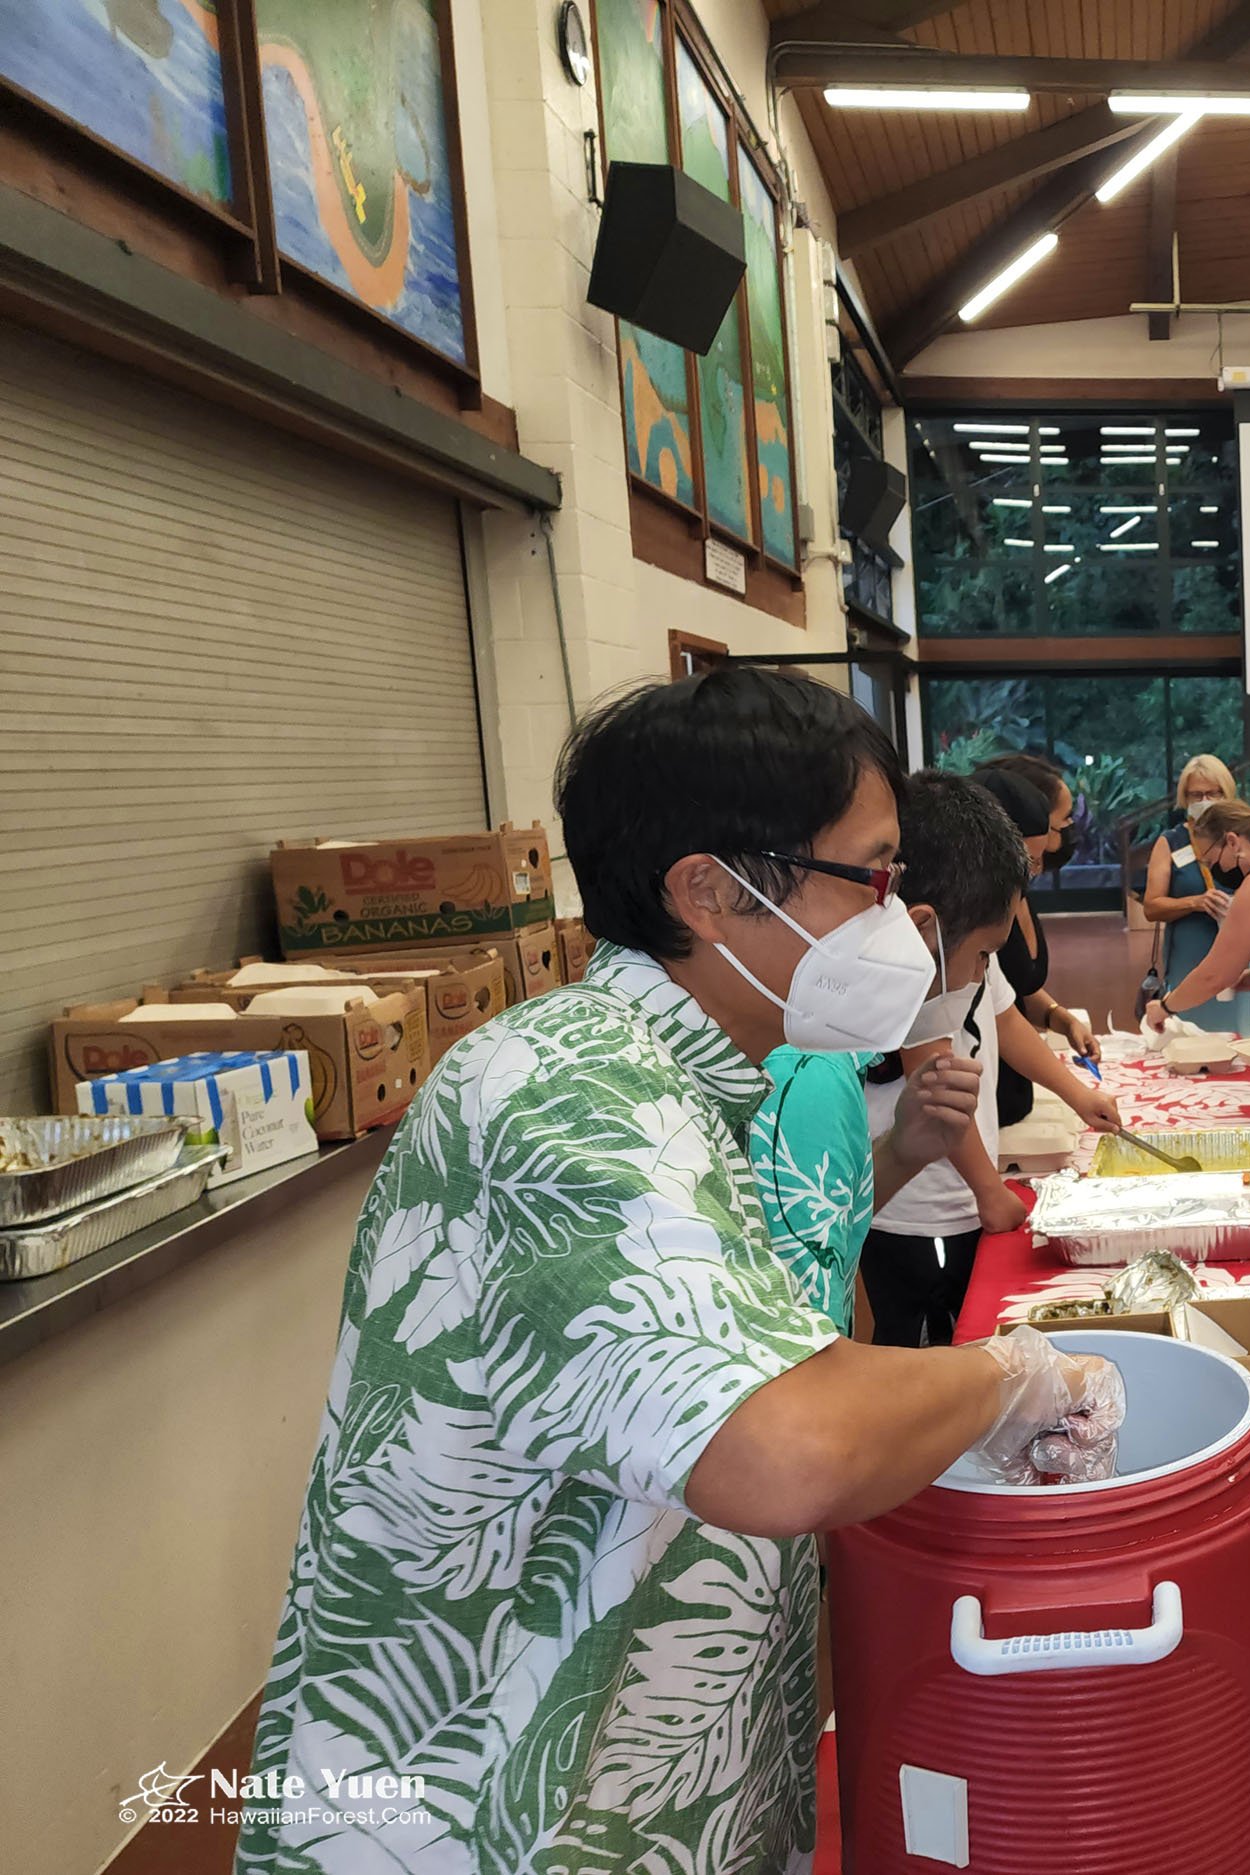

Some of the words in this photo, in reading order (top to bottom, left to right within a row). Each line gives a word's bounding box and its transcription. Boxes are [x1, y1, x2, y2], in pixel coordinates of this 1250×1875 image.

[339, 850, 436, 889] Dole
[360, 901, 427, 918] ORGANIC
[321, 915, 473, 945] BANANAS
[83, 1044, 149, 1071] Dole
